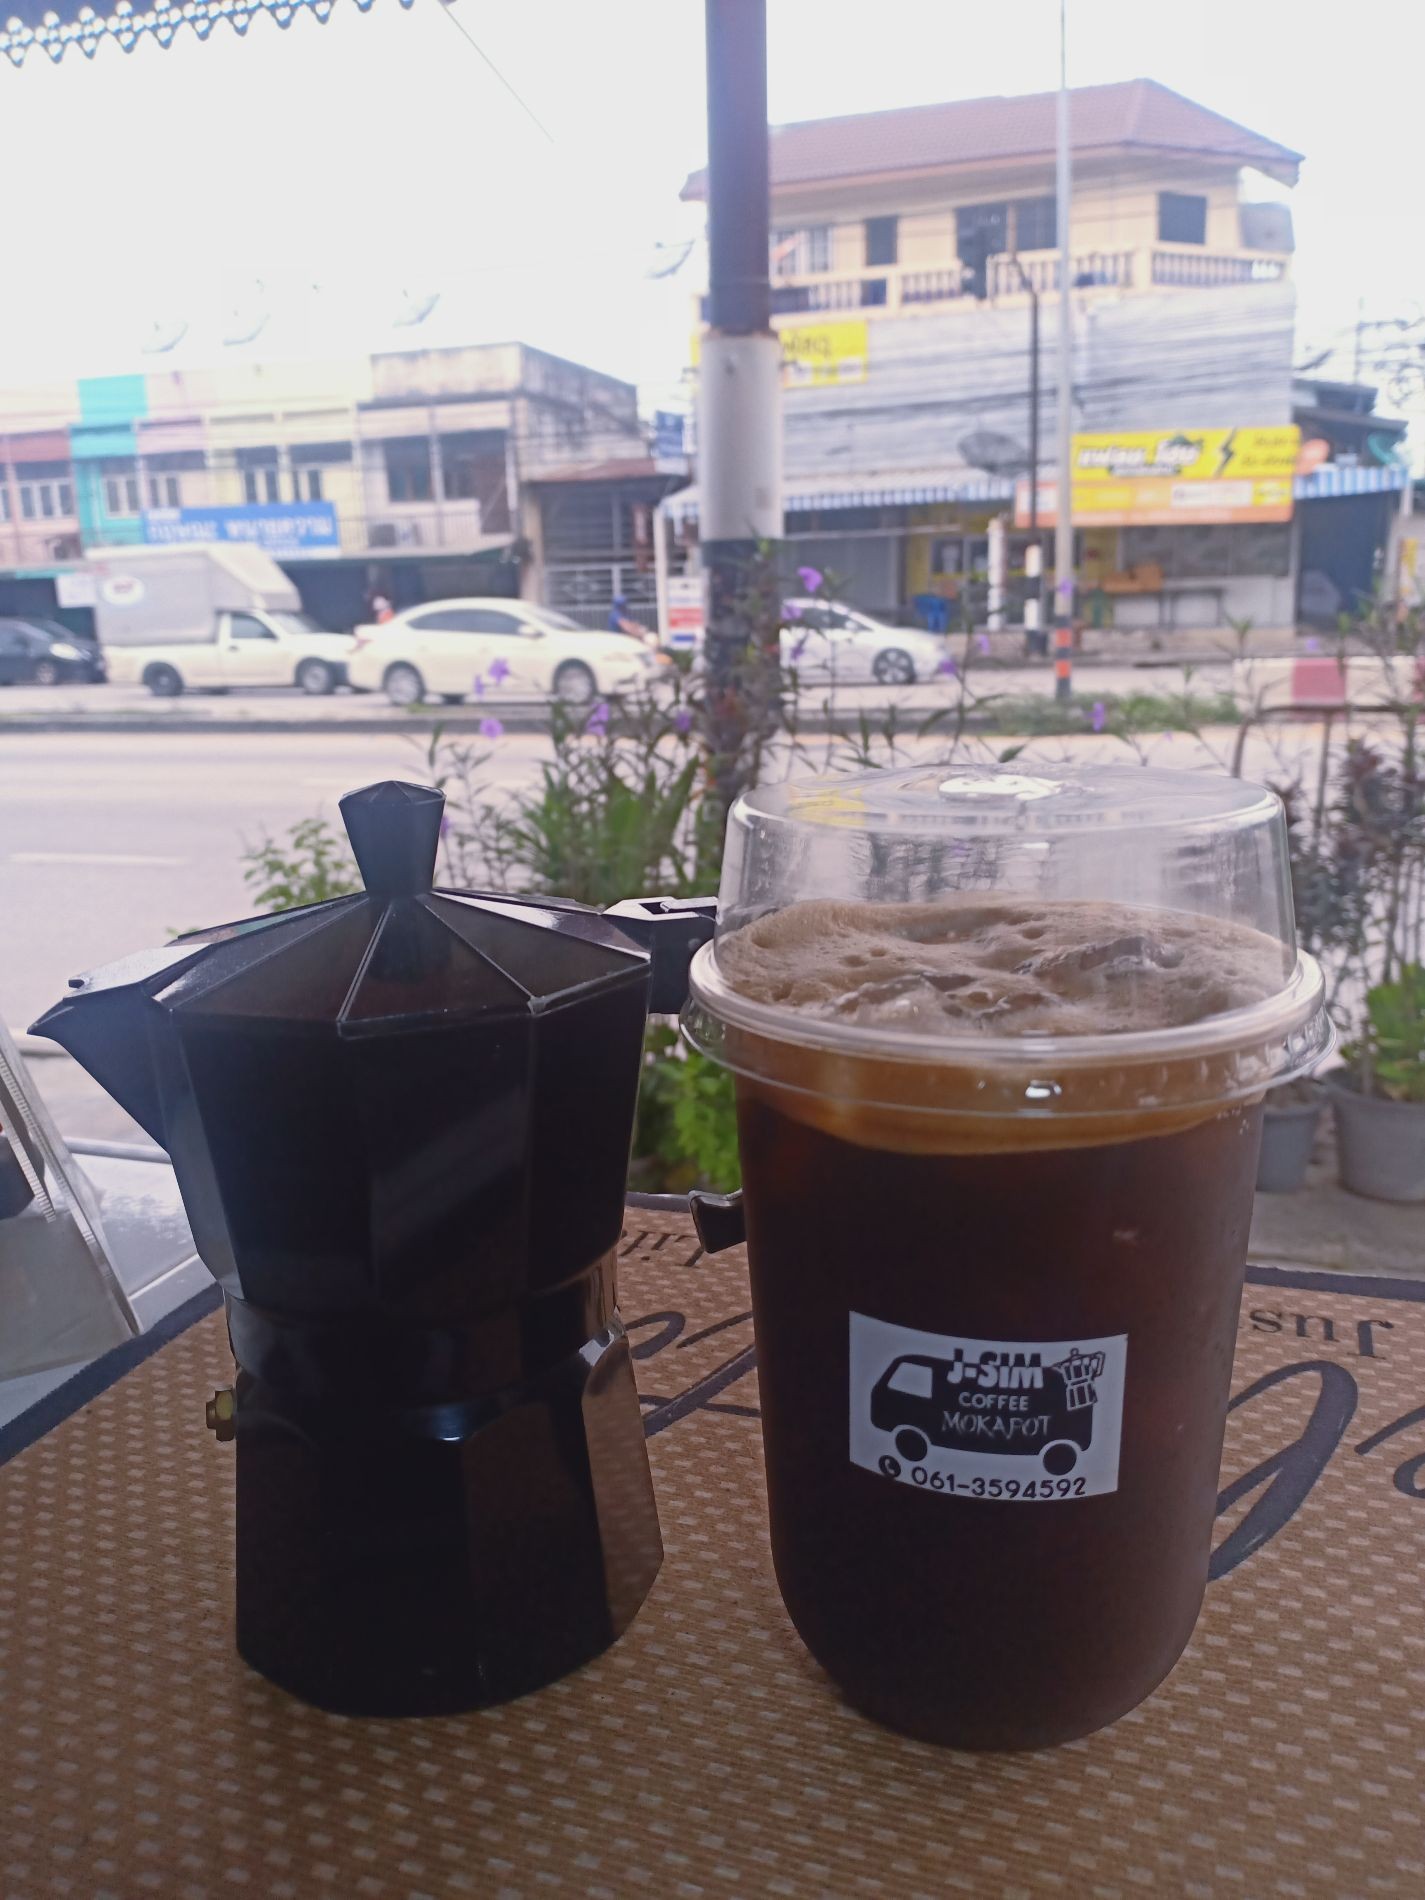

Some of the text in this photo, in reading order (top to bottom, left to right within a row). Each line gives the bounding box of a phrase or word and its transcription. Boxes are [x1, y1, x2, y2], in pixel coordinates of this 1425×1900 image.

[947, 1348, 1044, 1389] J-SIM
[958, 1391, 1030, 1412] COFFEE
[940, 1410, 1052, 1440] MOKAPOT
[911, 1466, 1087, 1499] 061-3594592
